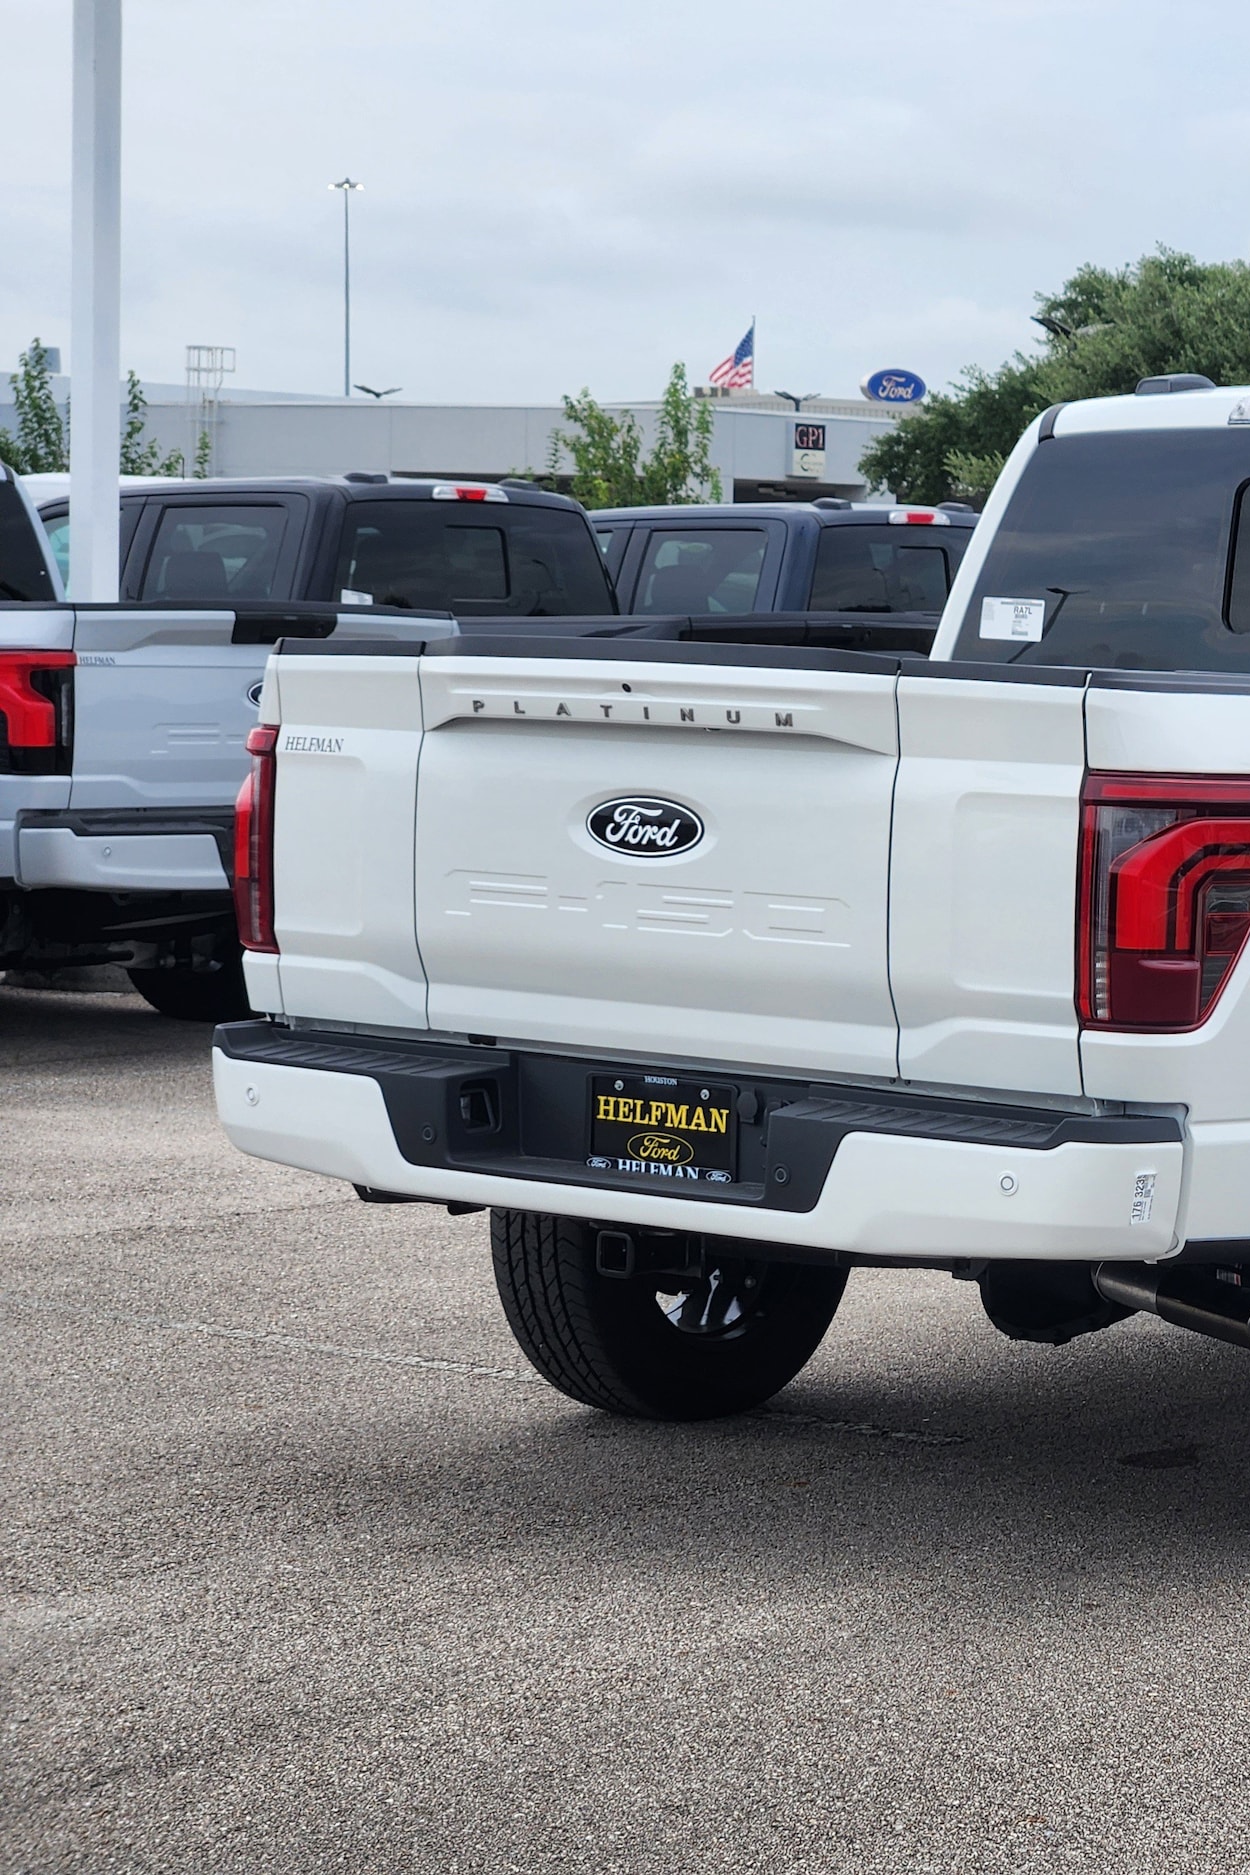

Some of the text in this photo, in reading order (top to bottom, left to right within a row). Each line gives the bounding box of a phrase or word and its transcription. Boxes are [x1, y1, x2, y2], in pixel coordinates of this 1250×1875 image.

[878, 375, 914, 399] Ford
[1013, 606, 1032, 614] RA7L
[79, 656, 116, 665] HELFMAN
[472, 700, 793, 727] PLATINUM
[284, 736, 344, 752] HELFMAN
[605, 804, 681, 847] Ford
[644, 1075, 678, 1086] HOUSTON
[596, 1095, 729, 1133] HELFMAN
[639, 1135, 681, 1161] Ford
[617, 1158, 699, 1179] HELFMAN
[1131, 1200, 1141, 1219] 176
